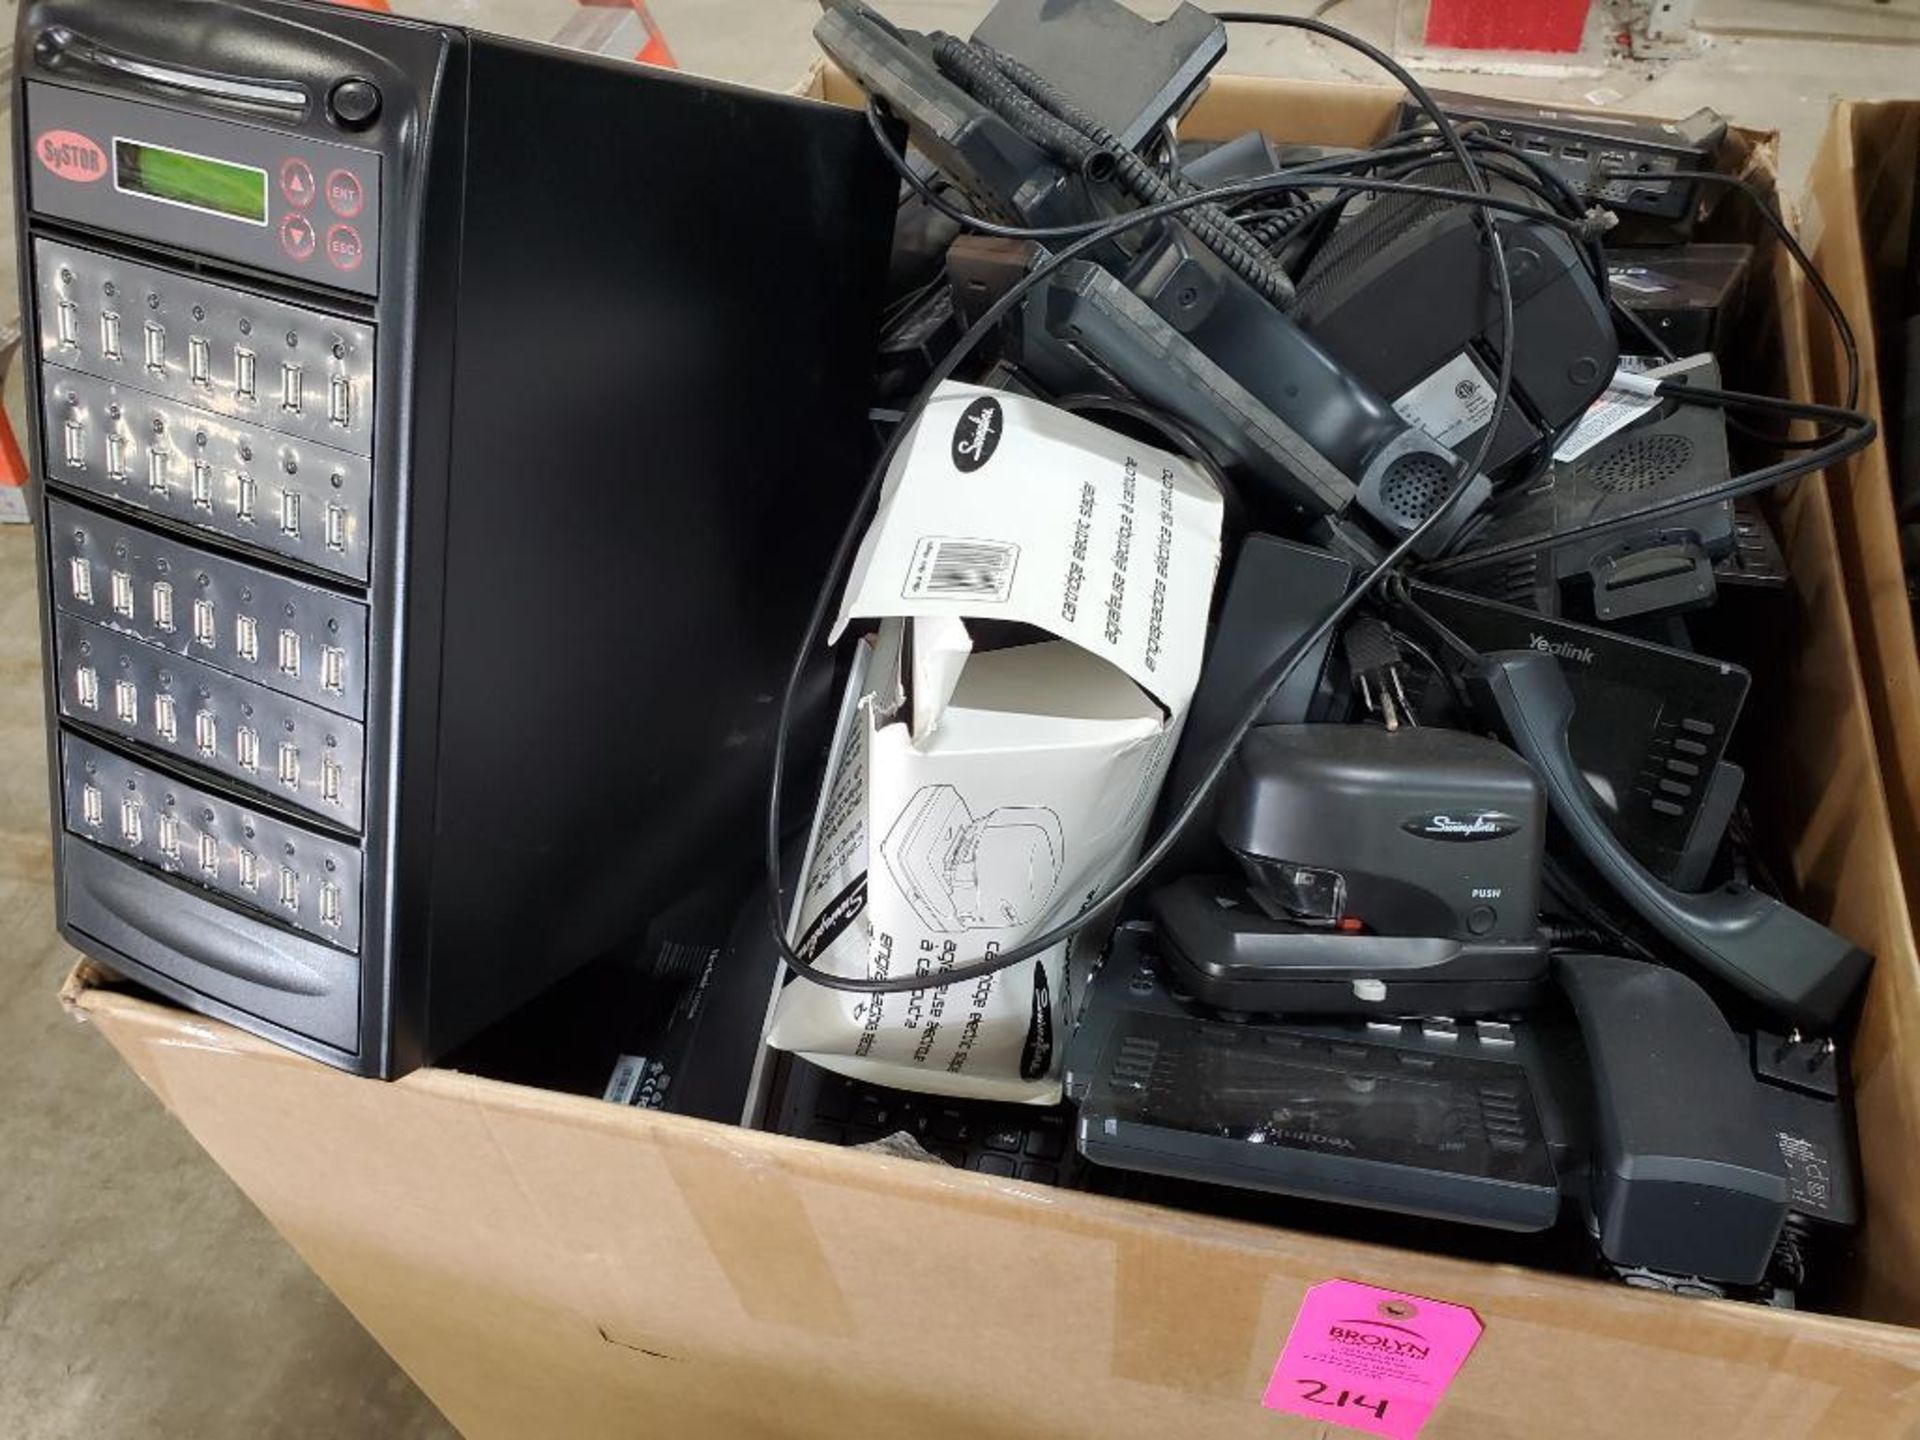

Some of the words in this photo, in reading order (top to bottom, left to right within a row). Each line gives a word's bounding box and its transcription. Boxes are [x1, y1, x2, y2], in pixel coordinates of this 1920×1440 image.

[44, 138, 99, 172] SySTOR
[333, 186, 355, 201] ENT
[332, 241, 355, 257] ESC
[1072, 519, 1091, 562] electric
[1061, 560, 1084, 623] cartridge
[1529, 632, 1595, 664] Yealink
[1471, 888, 1501, 899] PUSH
[1329, 1326, 1430, 1357] BROLYN
[1297, 1379, 1388, 1420] 214
